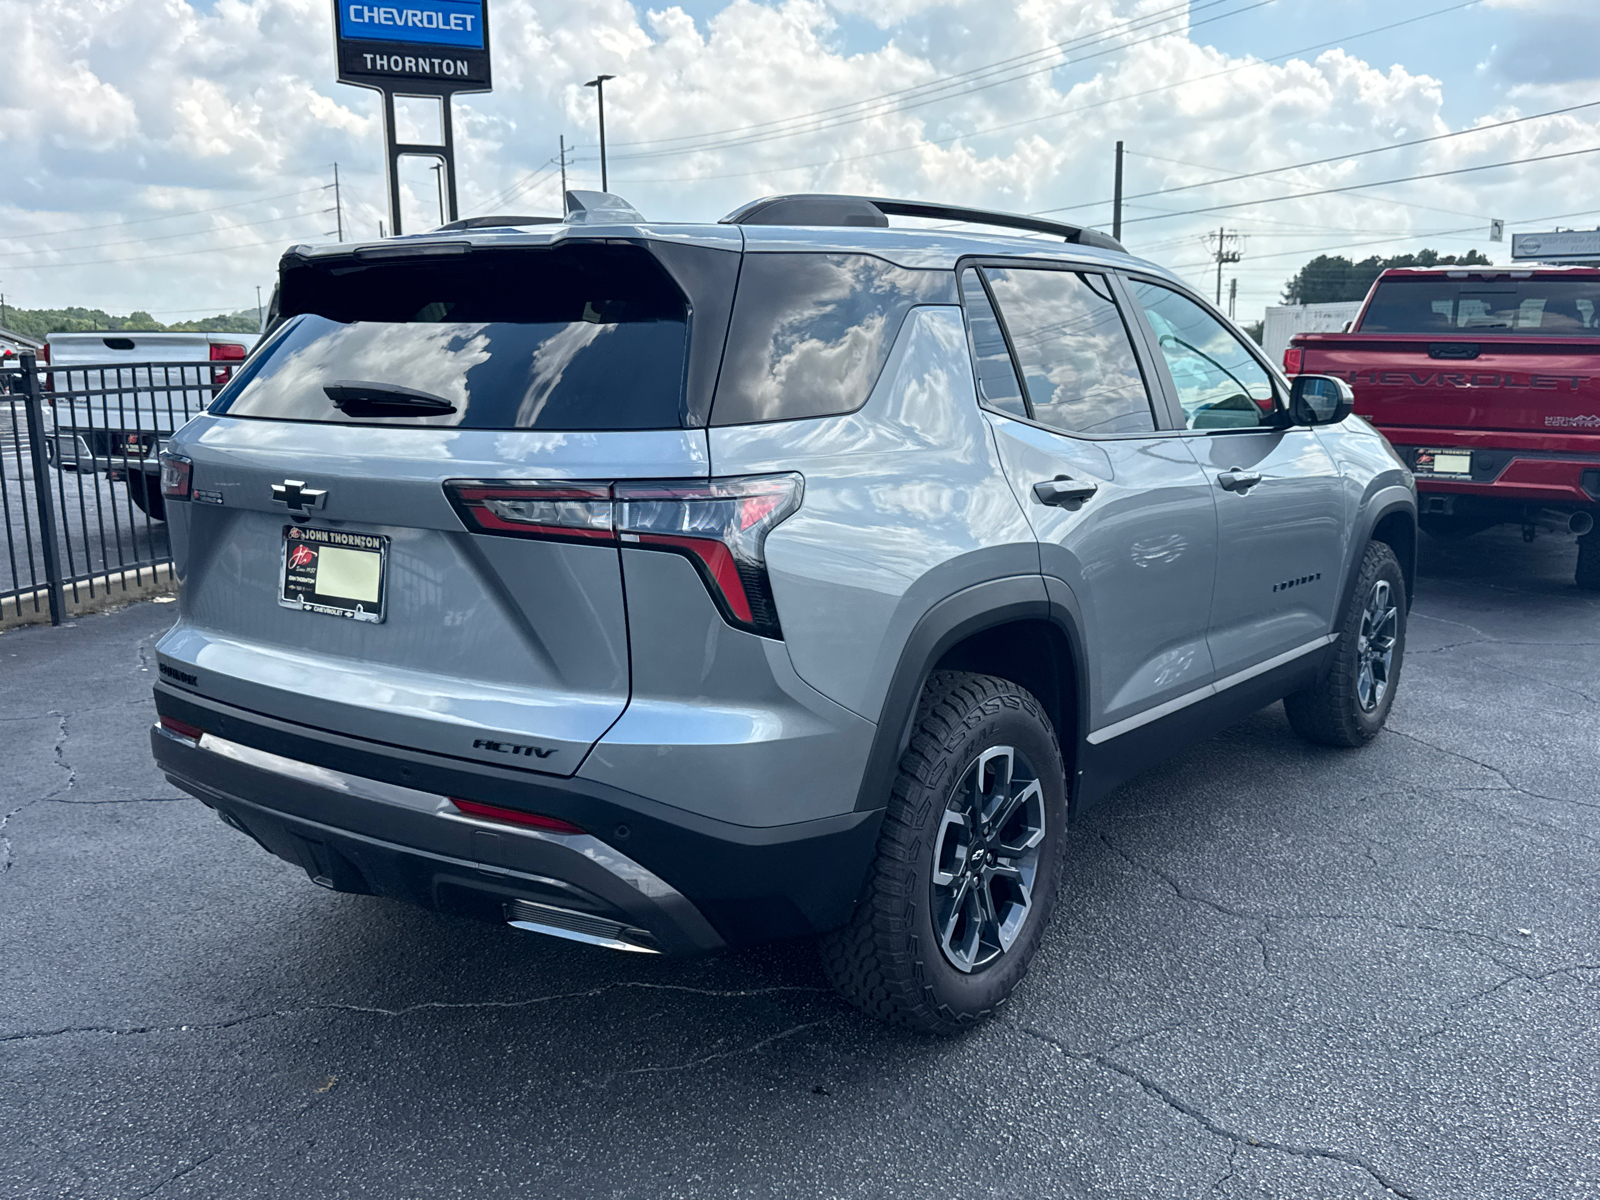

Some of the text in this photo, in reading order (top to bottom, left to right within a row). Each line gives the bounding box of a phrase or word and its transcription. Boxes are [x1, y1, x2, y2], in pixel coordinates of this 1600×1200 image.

[349, 5, 475, 32] CHEVROLET
[363, 53, 469, 76] THORNTON
[305, 529, 329, 542] JOHN
[330, 532, 380, 549] THORNTON
[313, 605, 343, 616] CHEVROLET
[472, 739, 559, 759] ACTIV
